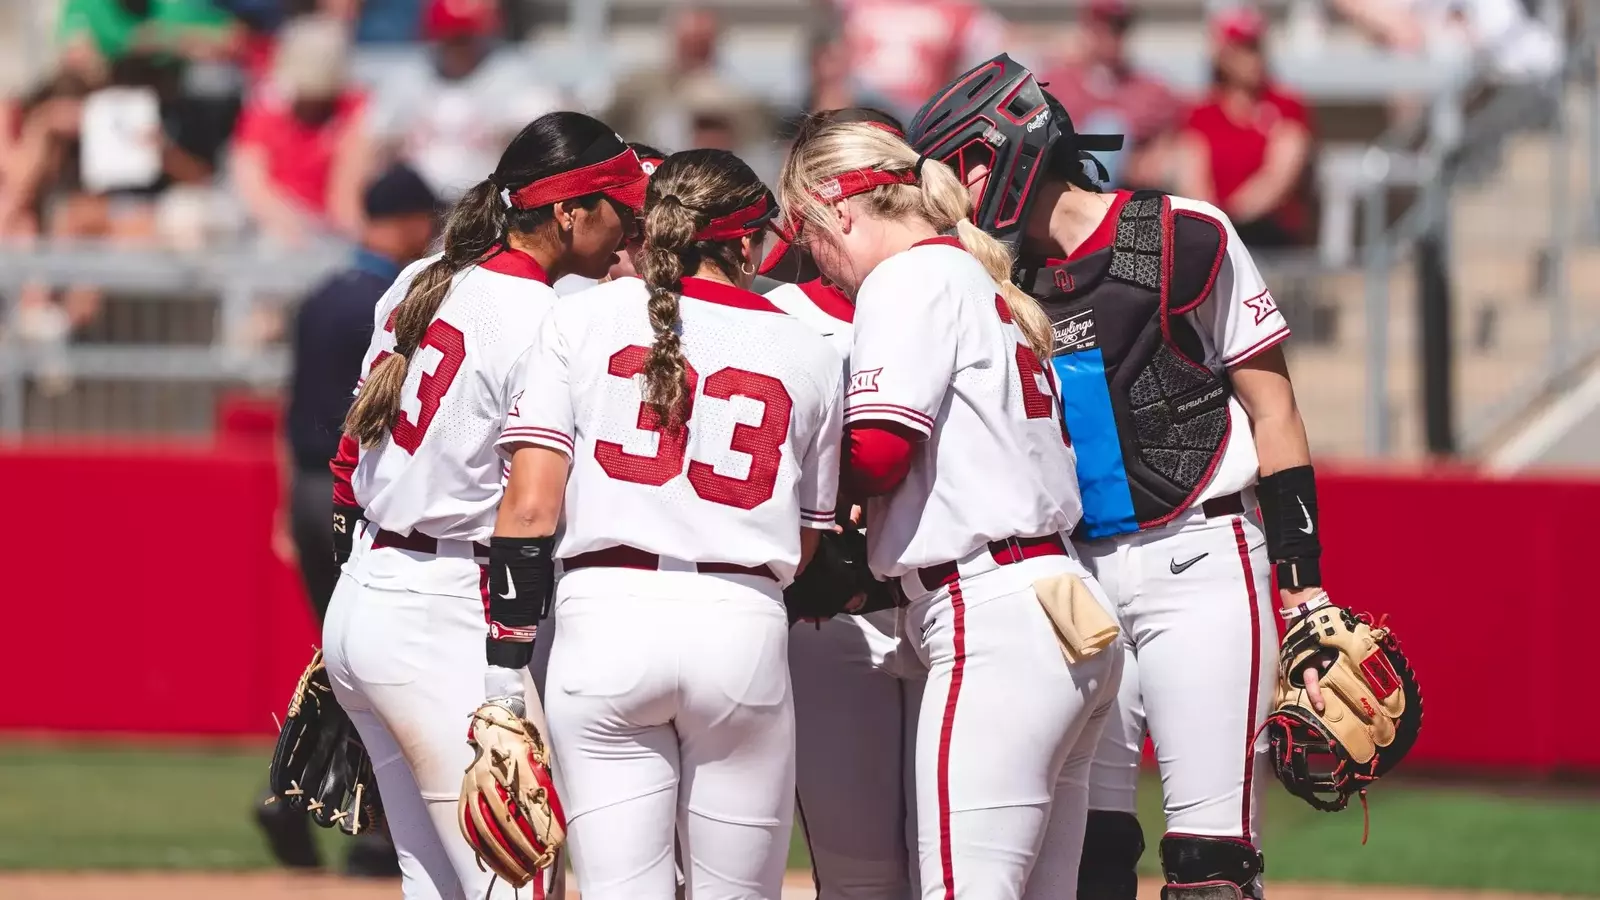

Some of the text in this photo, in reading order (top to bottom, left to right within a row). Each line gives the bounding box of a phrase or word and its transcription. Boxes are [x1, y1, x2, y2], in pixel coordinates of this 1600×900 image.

[1177, 386, 1224, 413] RAWLINGS
[593, 344, 793, 511] 33
[333, 512, 347, 534] 23
